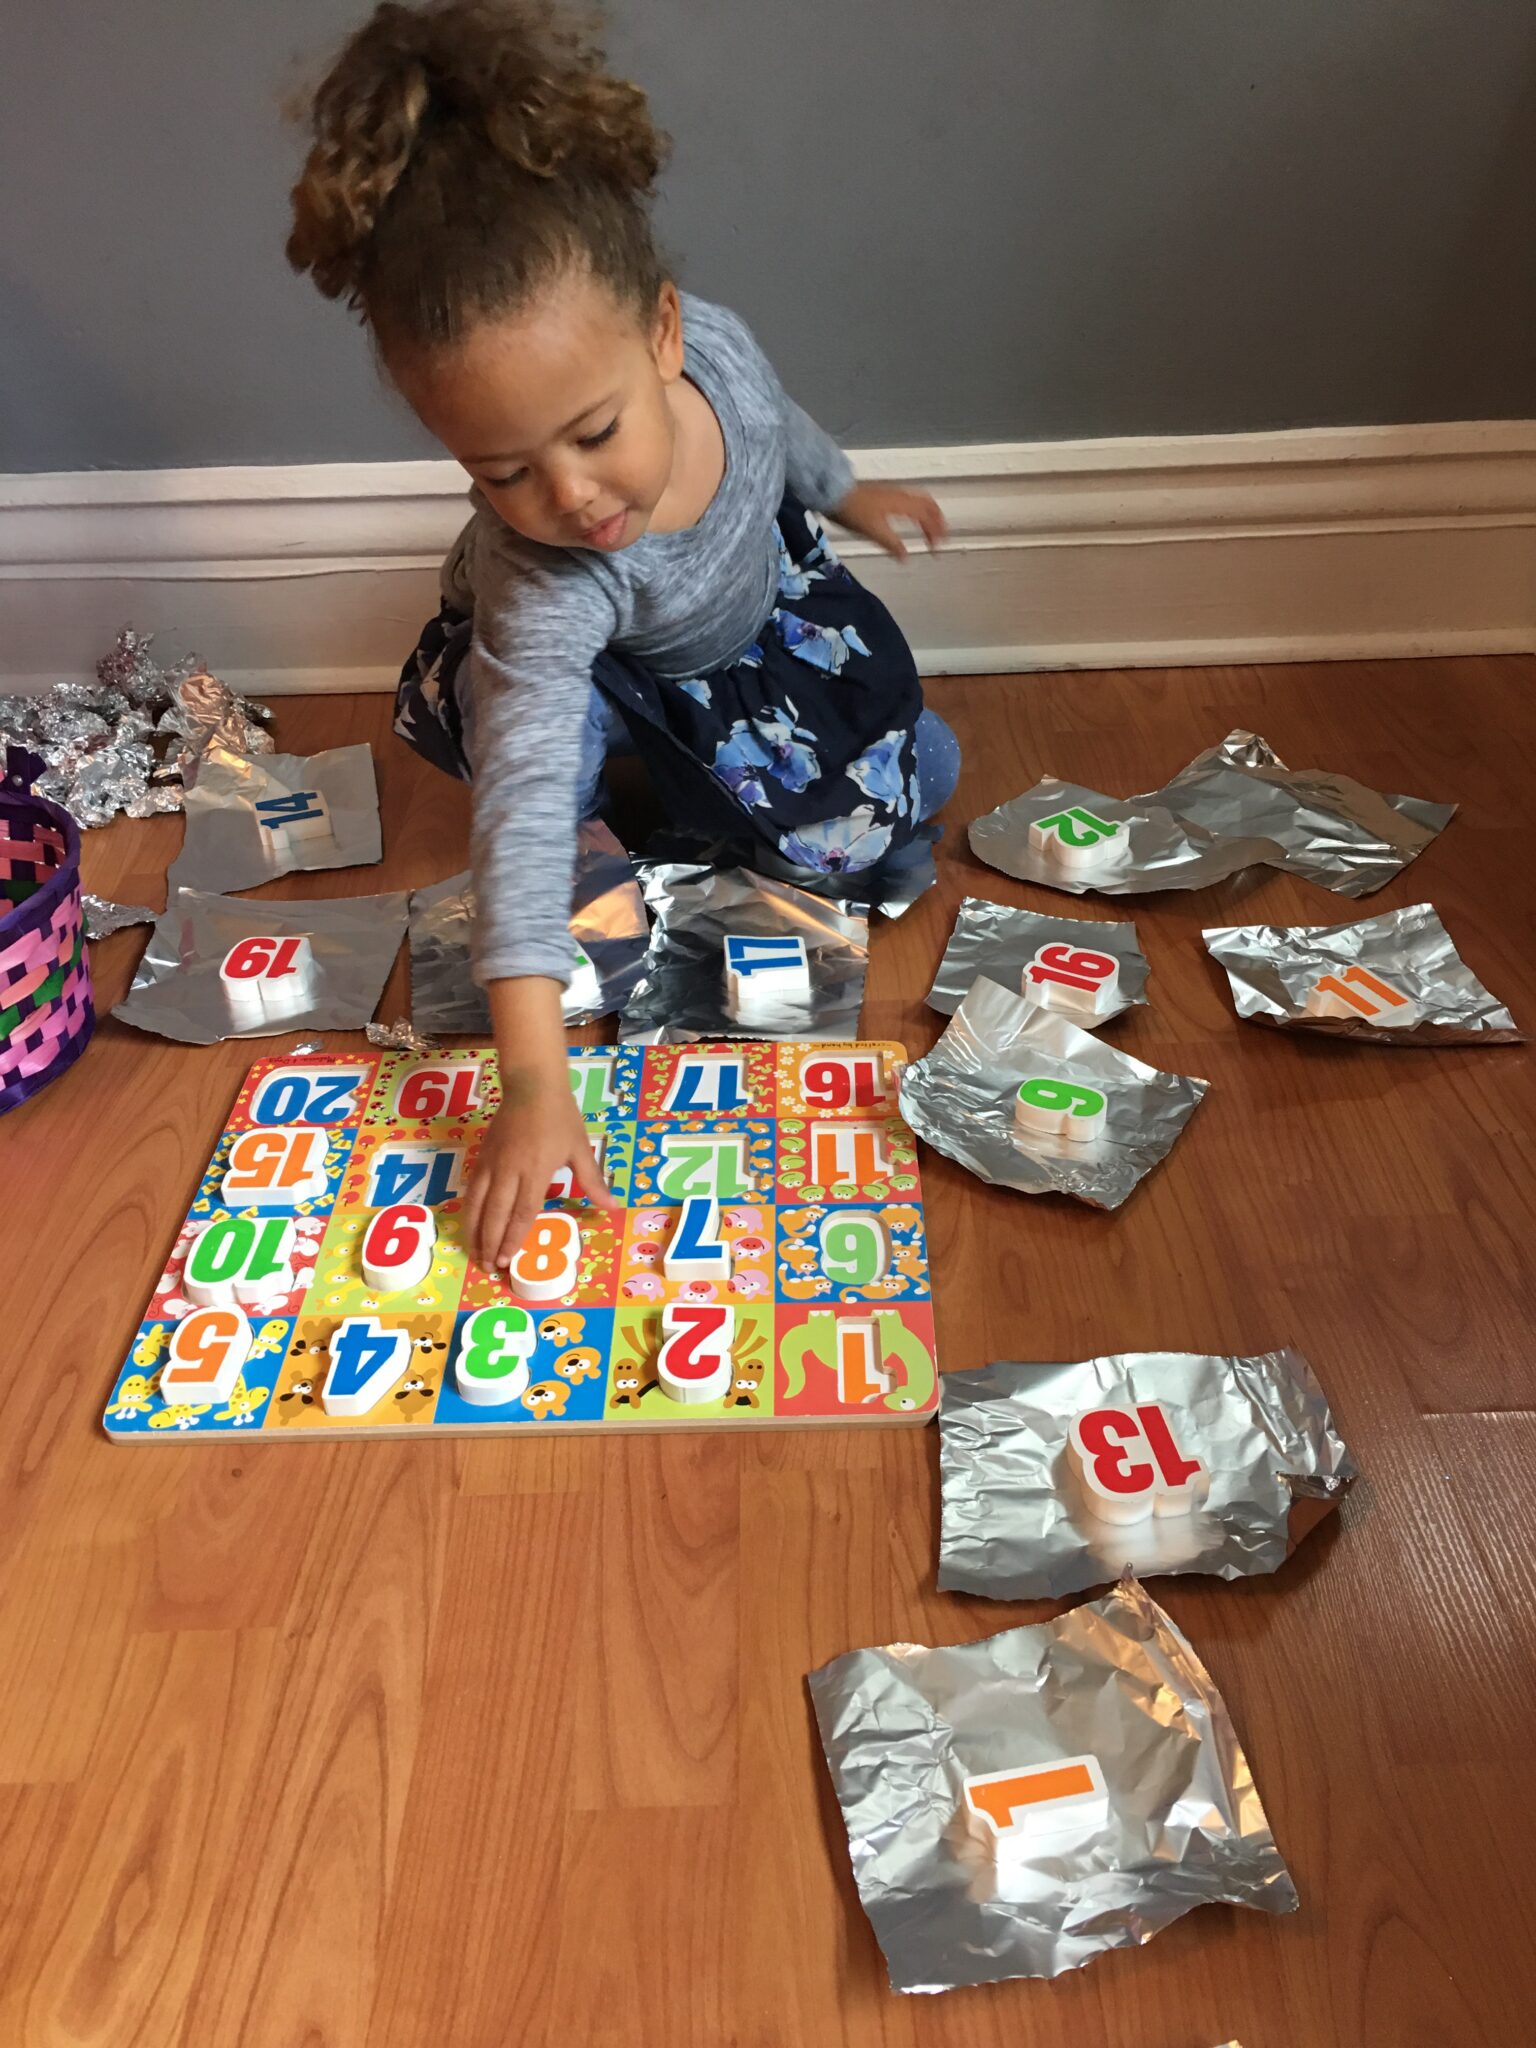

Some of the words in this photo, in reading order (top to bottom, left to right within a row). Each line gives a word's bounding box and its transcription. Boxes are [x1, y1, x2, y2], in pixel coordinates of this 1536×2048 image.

[254, 791, 324, 830] 14
[1035, 807, 1119, 847] 12
[224, 937, 302, 979] 19
[727, 936, 803, 977] 17
[1027, 945, 1115, 994] 16
[1314, 965, 1409, 1017] 11
[256, 1075, 362, 1125] 20
[397, 1069, 477, 1119] 19
[570, 1067, 614, 1113] 1
[671, 1065, 748, 1111] 17
[804, 1061, 887, 1109] 16
[228, 1132, 316, 1188] 15
[371, 1152, 458, 1207] 14
[662, 1145, 750, 1199] 12
[816, 1133, 889, 1186] 11
[190, 1218, 289, 1284] 10
[516, 1216, 572, 1281] 8
[670, 1199, 723, 1260] 7
[166, 1311, 240, 1383] 5
[328, 1323, 399, 1396] 4
[464, 1307, 529, 1380] 3
[665, 1307, 727, 1380] 2
[842, 1332, 881, 1404] 1
[1078, 1404, 1203, 1494] 13
[969, 1764, 1094, 1828] 1
